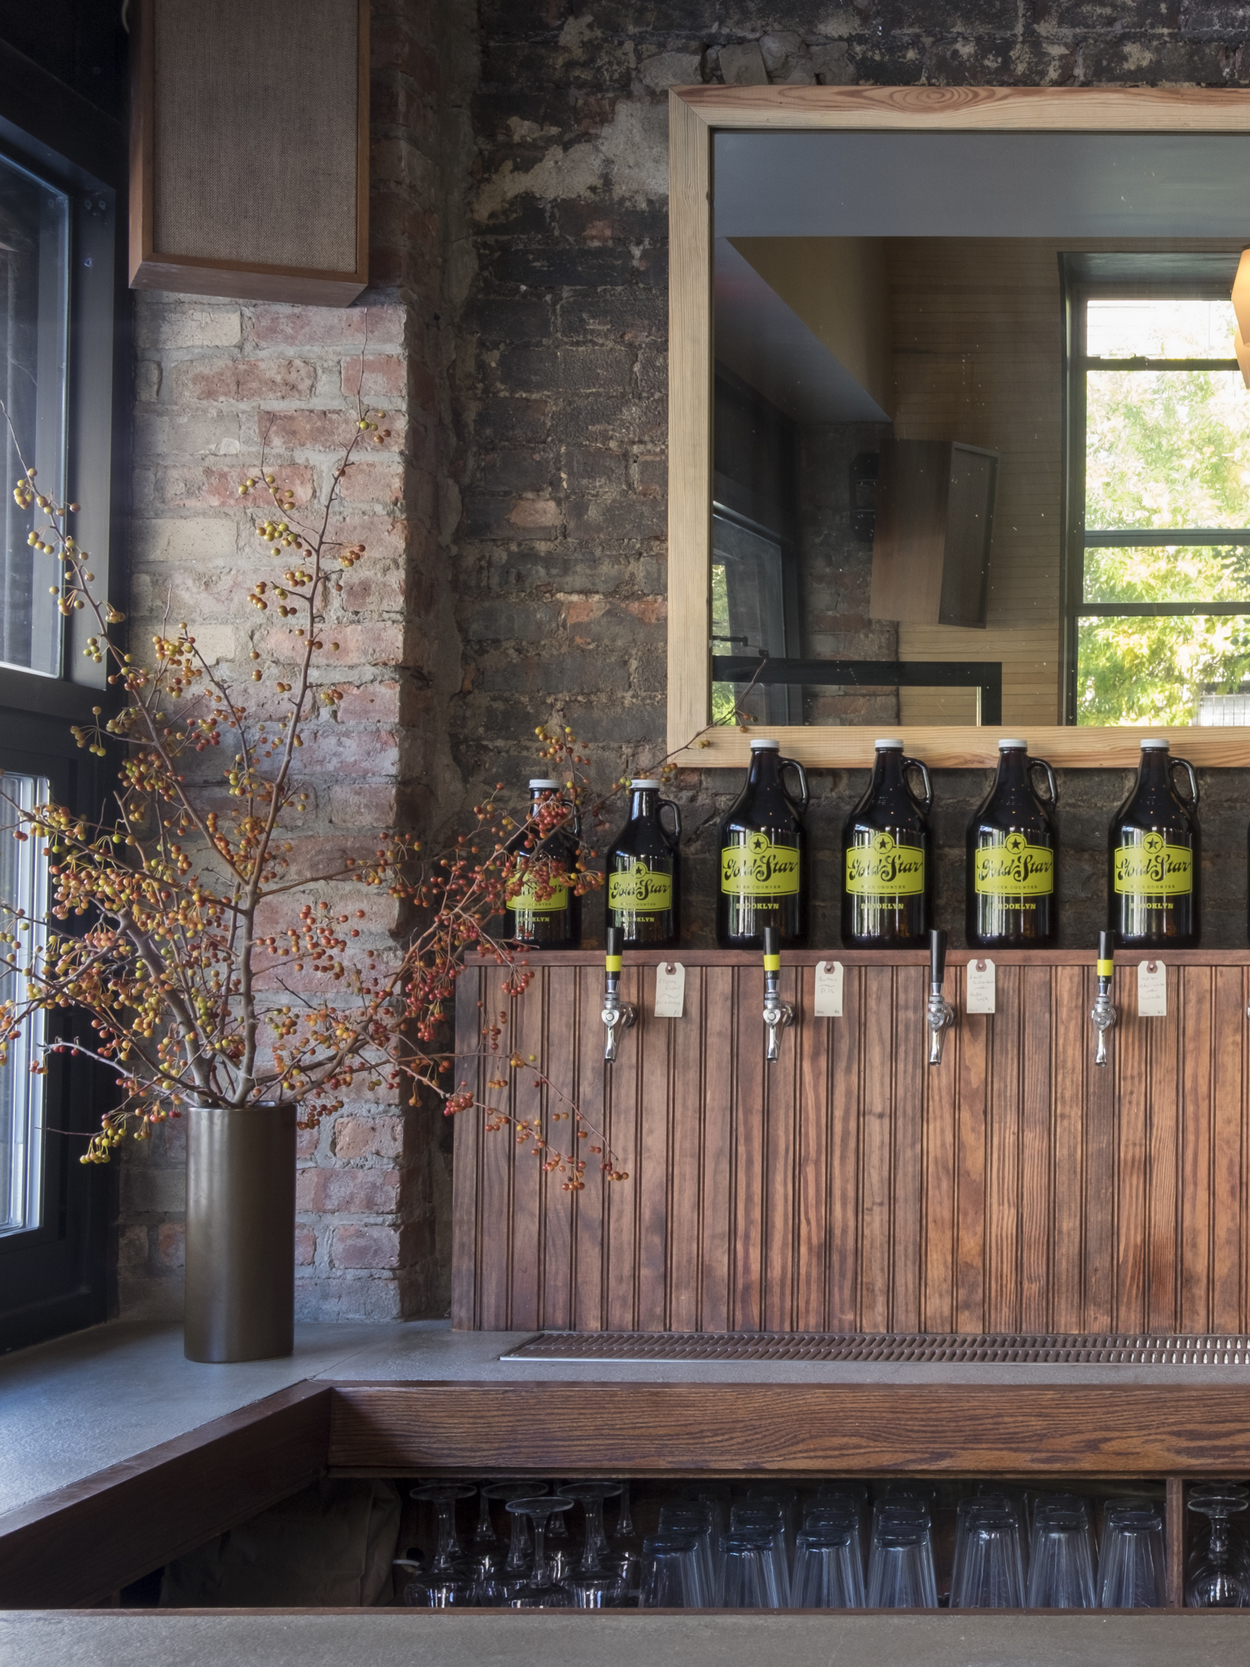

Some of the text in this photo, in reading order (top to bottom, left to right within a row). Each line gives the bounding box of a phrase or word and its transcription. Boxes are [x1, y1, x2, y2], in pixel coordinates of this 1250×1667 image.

[756, 854, 798, 882] Star
[881, 854, 923, 882] Star
[1013, 854, 1052, 882] Star
[1150, 854, 1191, 882] Star
[636, 879, 670, 901] Star
